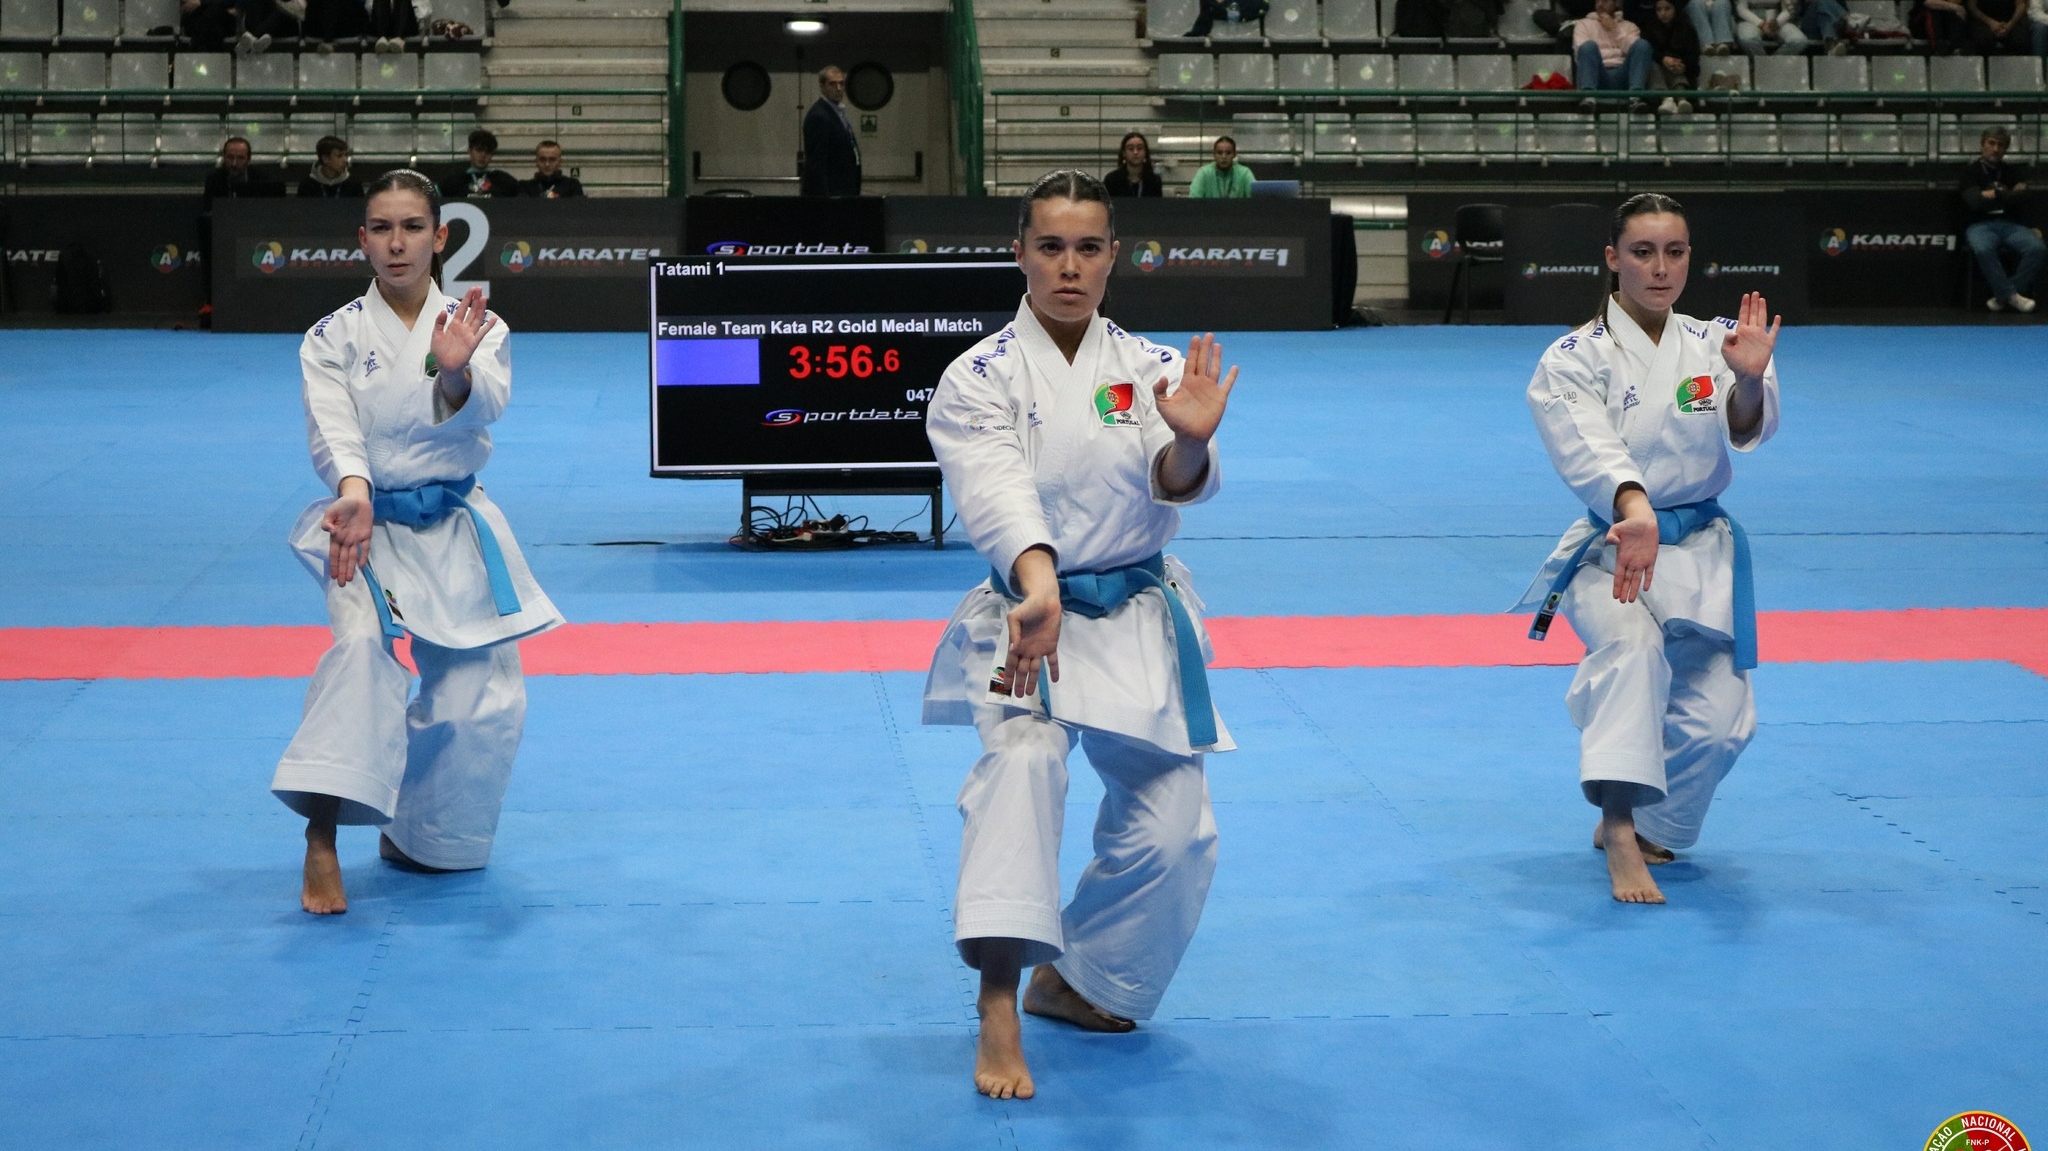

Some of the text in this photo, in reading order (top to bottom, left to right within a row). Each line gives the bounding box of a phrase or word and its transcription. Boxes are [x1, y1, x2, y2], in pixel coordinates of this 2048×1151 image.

[1852, 234, 1956, 250] KARATE1
[290, 248, 367, 261] KARA
[440, 202, 490, 300] 2
[1168, 248, 1289, 267] KARATE1
[656, 261, 724, 277] Tatami 1
[1539, 265, 1600, 276] KARATE1
[658, 317, 983, 336] Female Team Kata R2 Gold Medal Match
[789, 344, 900, 379] 3:56.6
